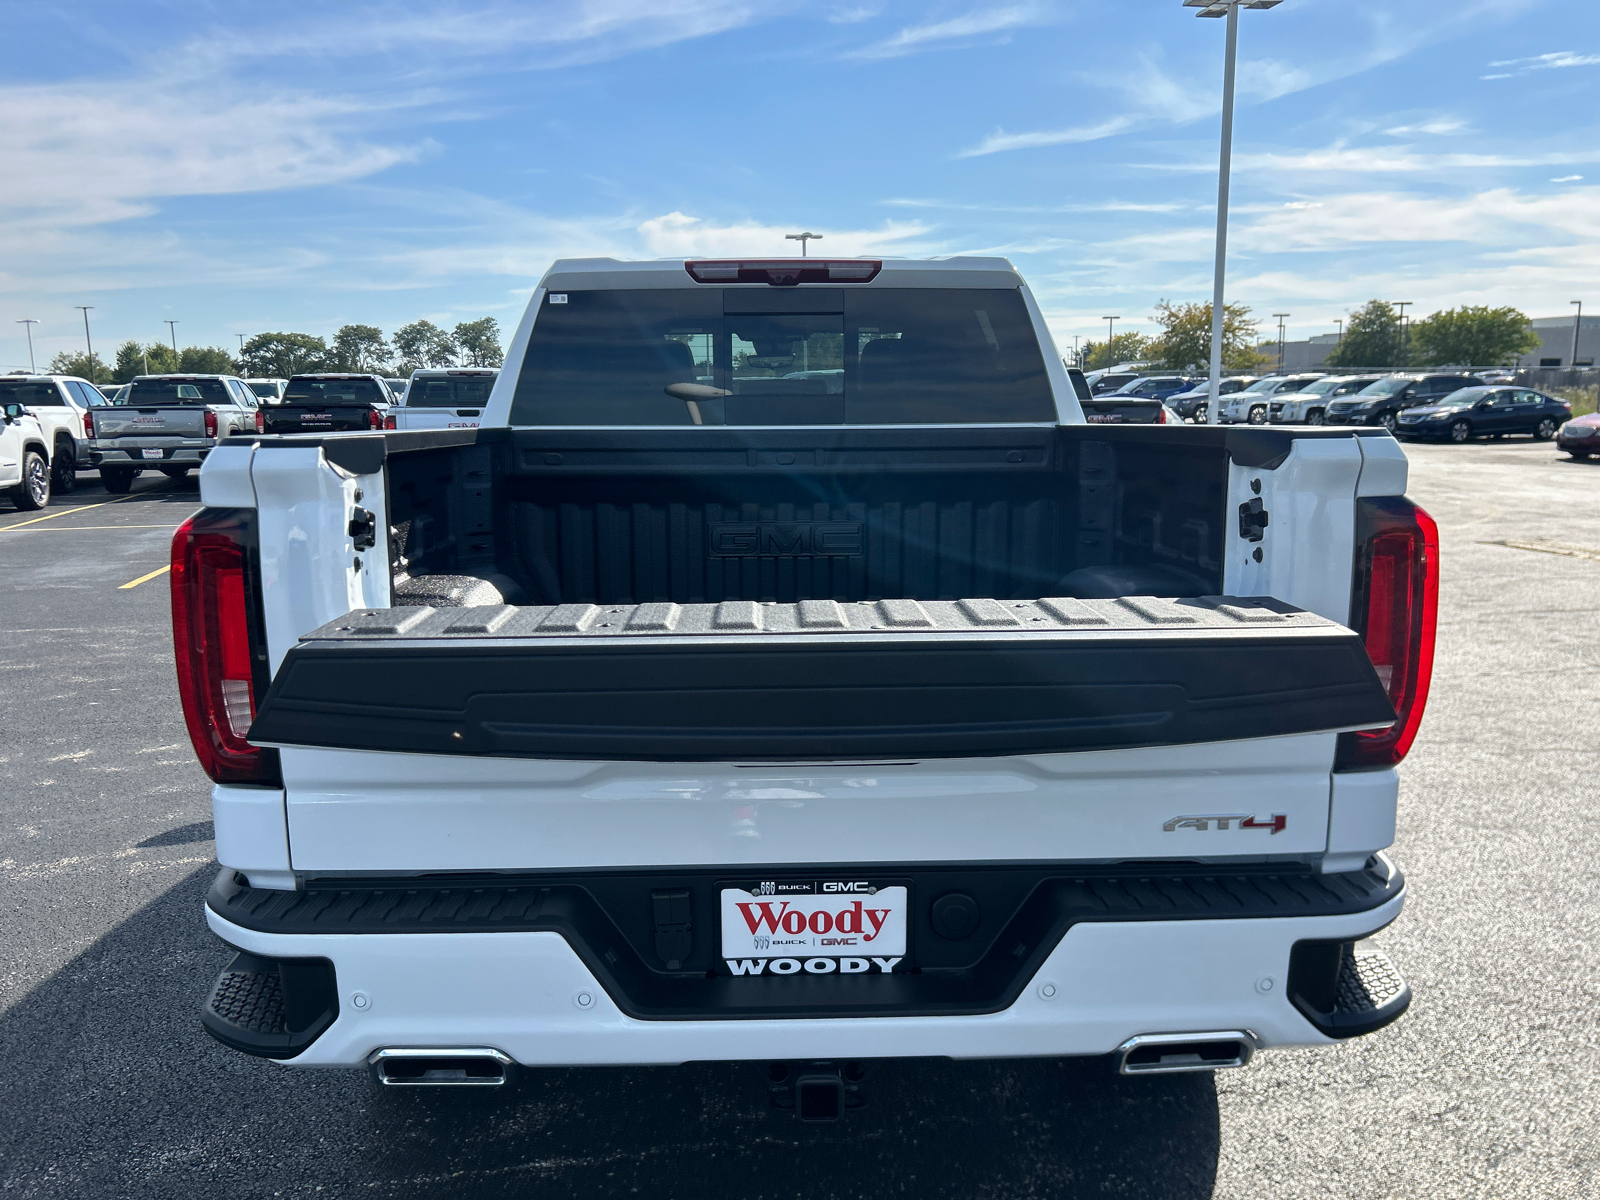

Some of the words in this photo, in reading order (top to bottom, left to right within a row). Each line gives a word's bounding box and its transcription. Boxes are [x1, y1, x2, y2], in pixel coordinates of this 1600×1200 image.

[711, 525, 862, 554] GMC
[1163, 812, 1287, 835] AT4
[823, 881, 869, 892] GMC
[735, 901, 892, 942] Woody
[820, 938, 858, 946] GMC
[725, 957, 903, 976] WOODY
